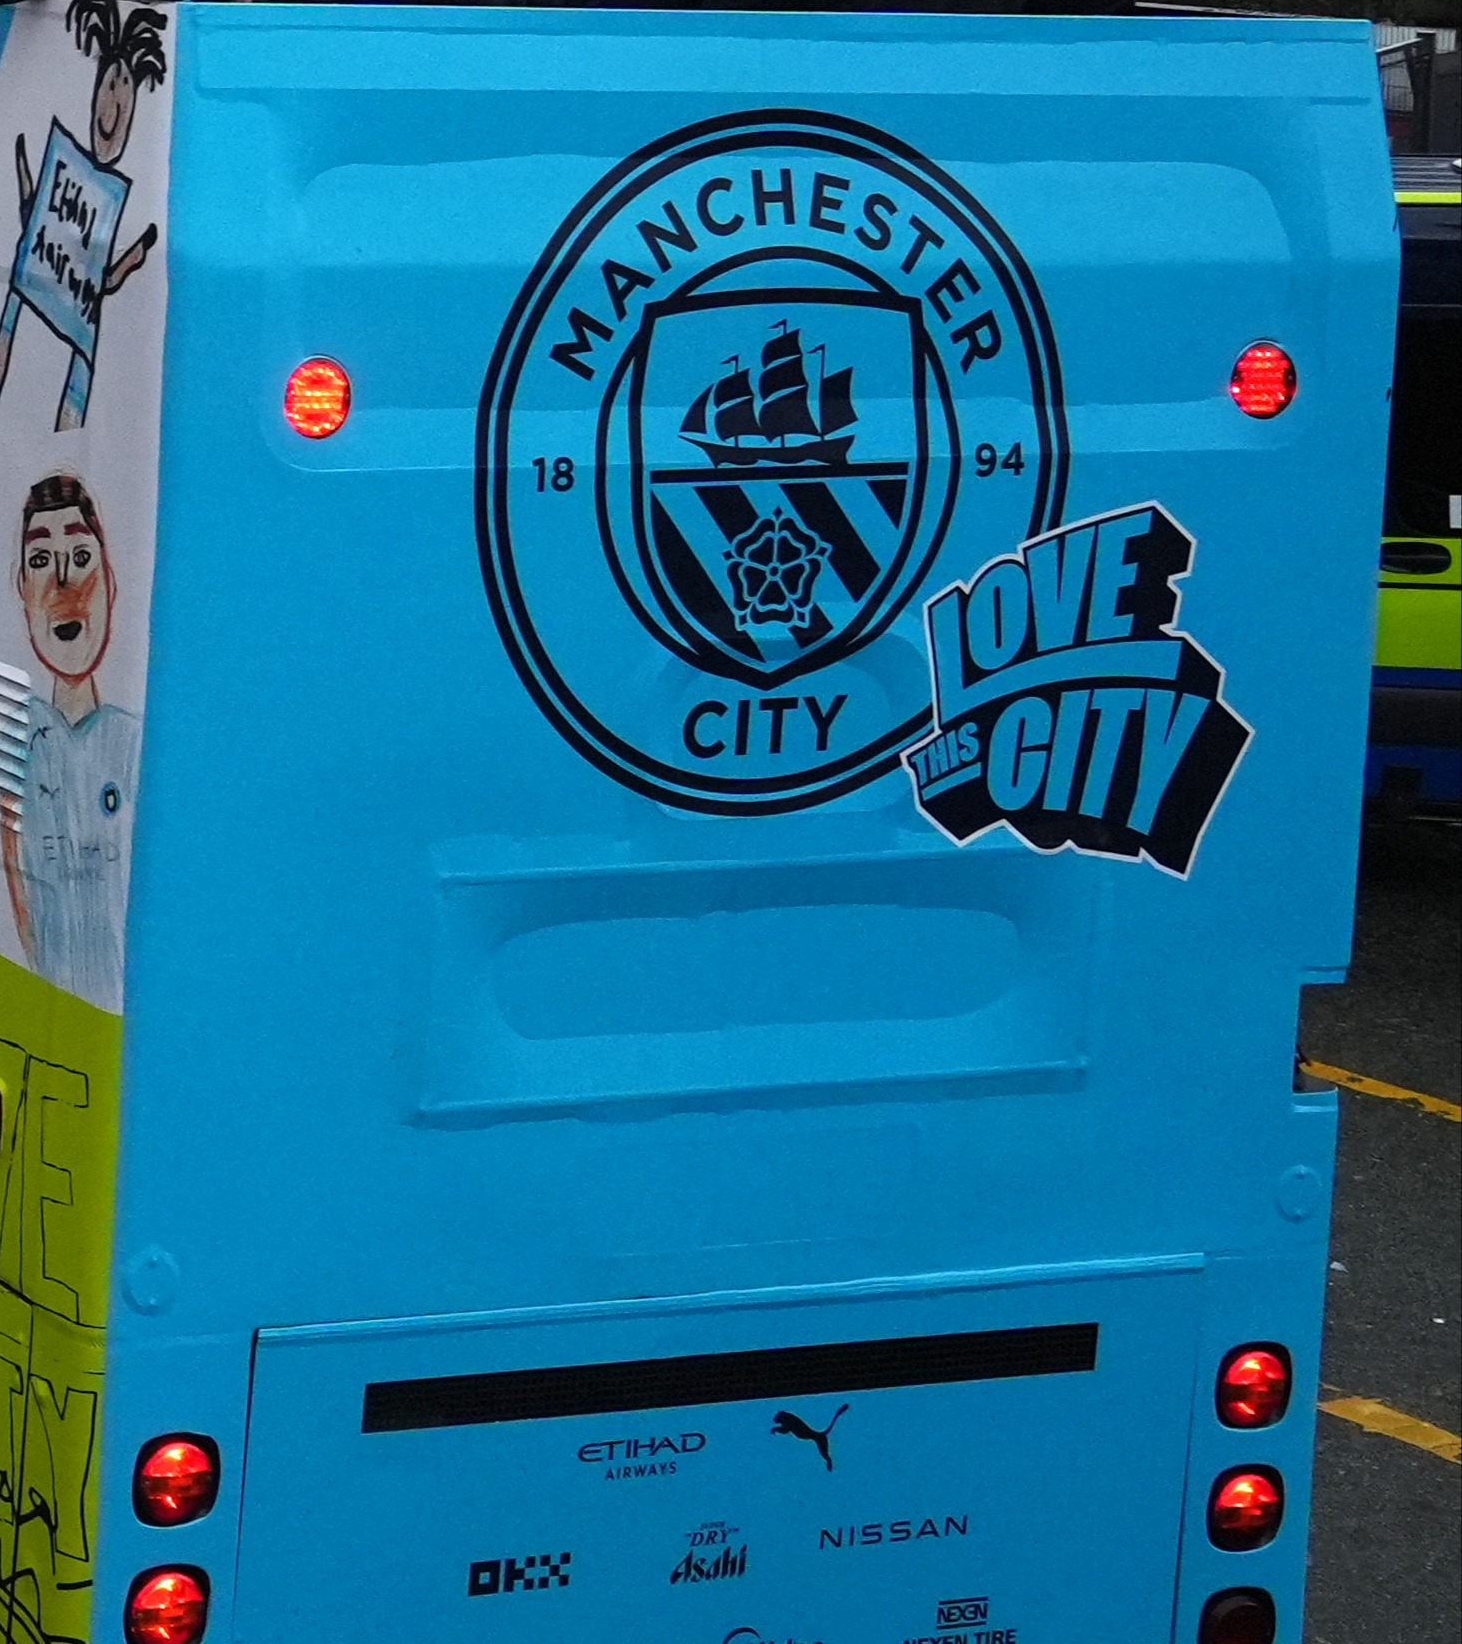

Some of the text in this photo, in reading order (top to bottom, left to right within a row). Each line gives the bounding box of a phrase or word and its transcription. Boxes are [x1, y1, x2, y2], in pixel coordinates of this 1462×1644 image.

[549, 167, 1003, 382] MANCHESTER
[532, 443, 1024, 493] 18 94
[931, 511, 1152, 725] LOVE
[683, 695, 848, 758] CITY
[911, 688, 1212, 836] THIS CITY
[578, 1432, 706, 1463] ETIHAD
[604, 1461, 678, 1481] AIRWAYS
[819, 1515, 968, 1550] NISSAN
[468, 1552, 571, 1596] OKX
[670, 1544, 747, 1585] Asahi
